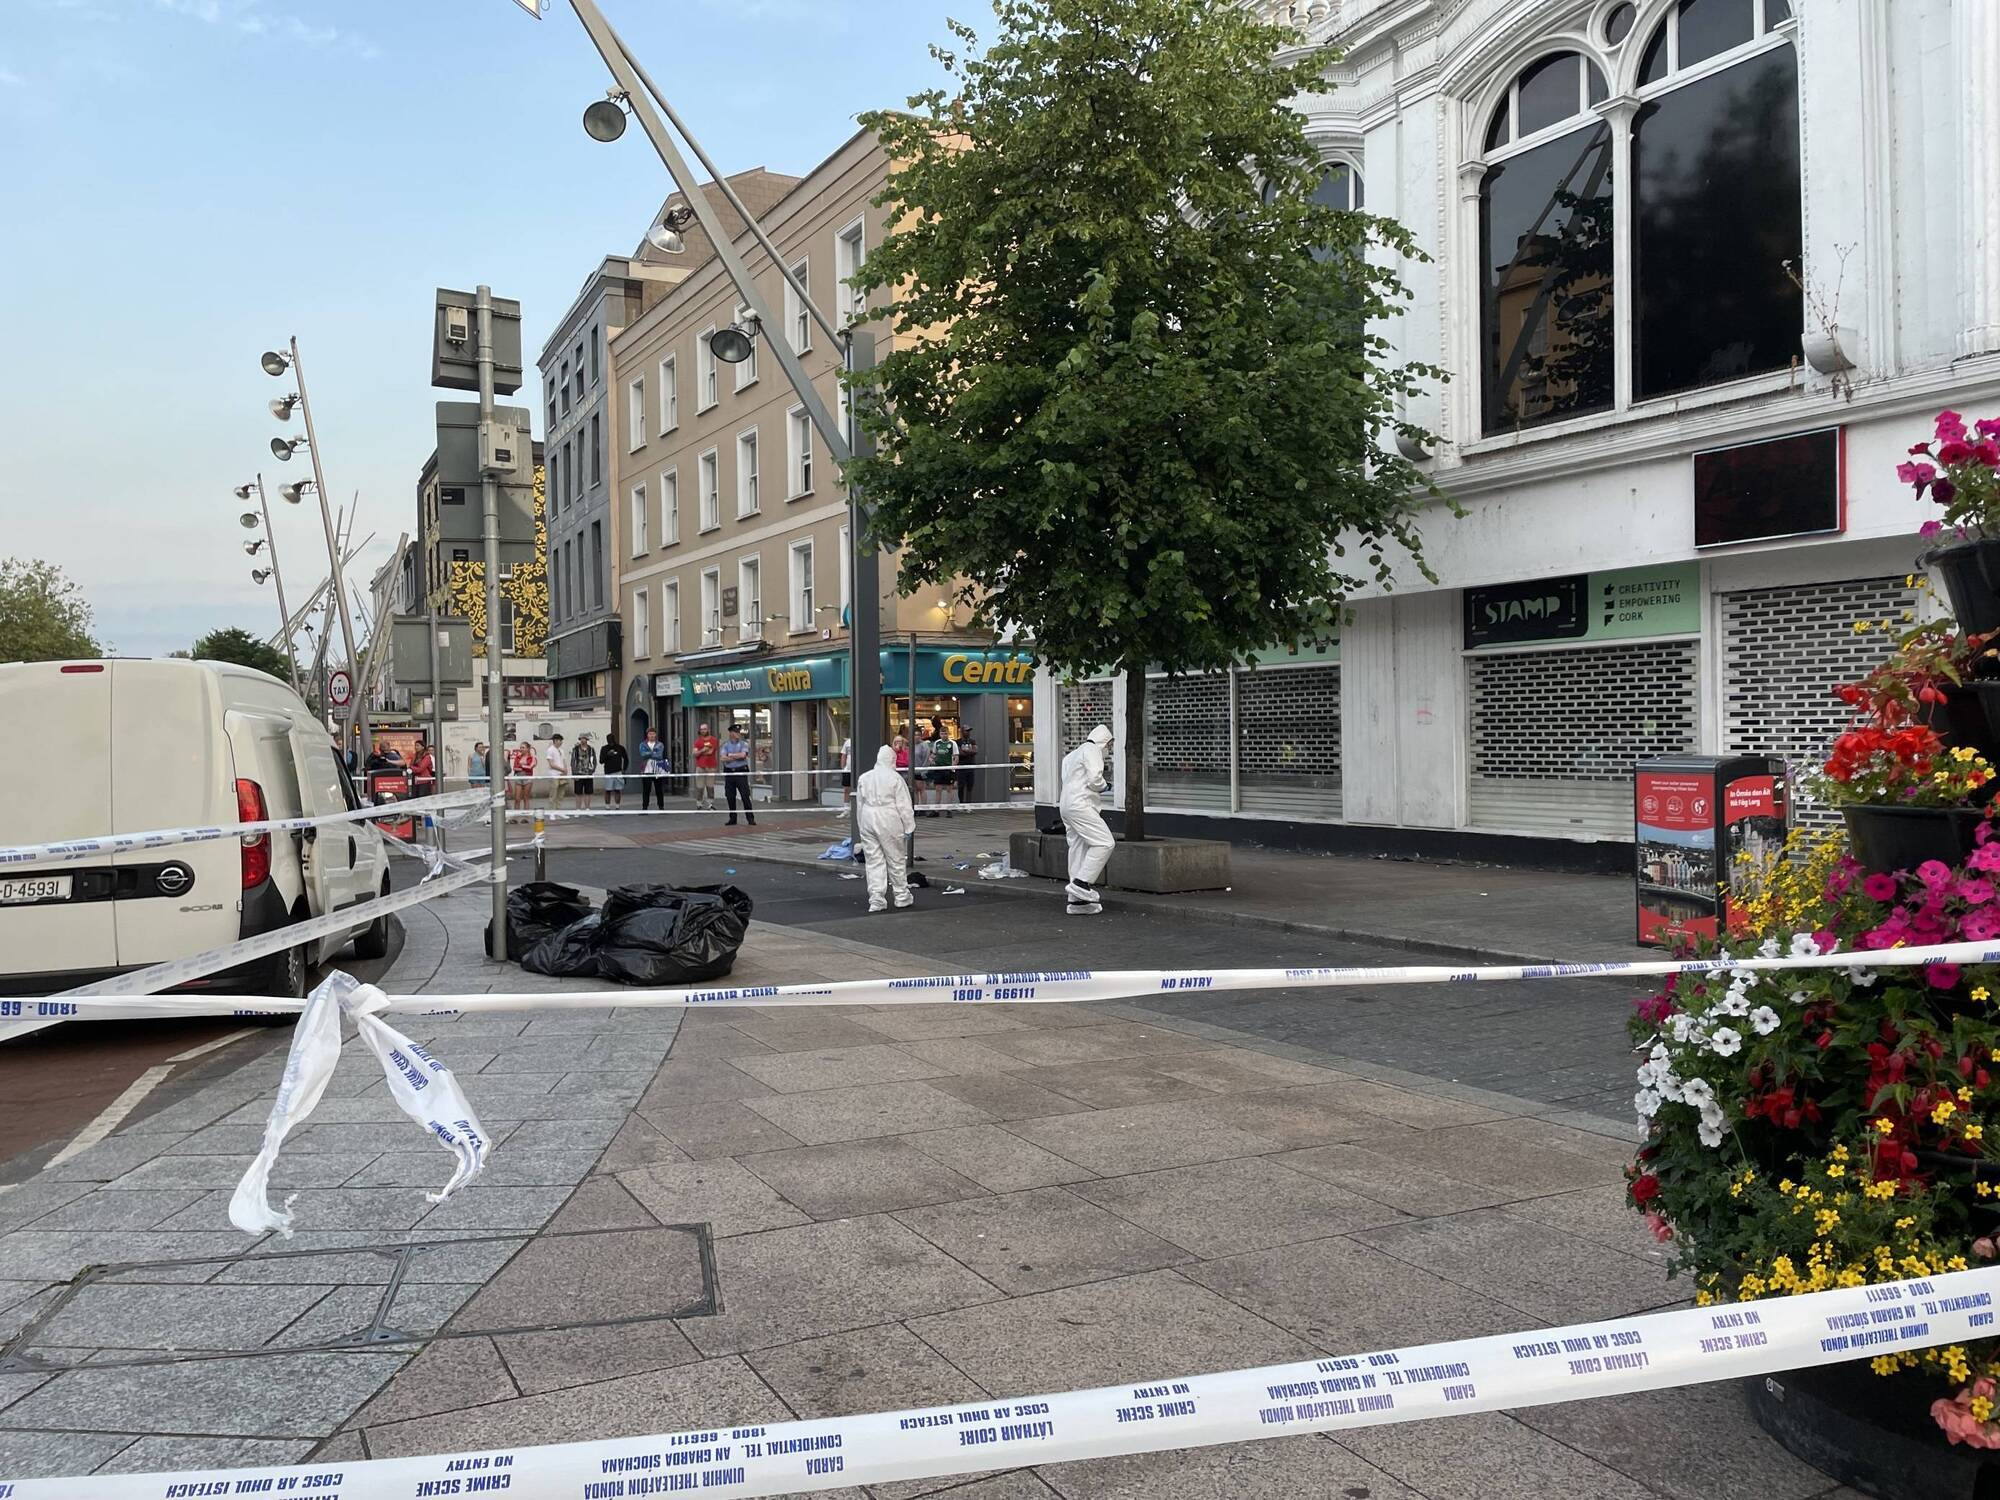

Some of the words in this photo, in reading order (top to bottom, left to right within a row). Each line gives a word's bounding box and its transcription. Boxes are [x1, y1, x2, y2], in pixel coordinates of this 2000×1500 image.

[1618, 579, 1681, 595] CREATIVITY
[1619, 594, 1681, 609] EMPOWERING
[1485, 596, 1561, 625] STAMP
[1619, 613, 1644, 622] CORK
[942, 654, 1033, 684] Centr
[767, 667, 812, 693] Centra
[1161, 978, 1177, 989] NO
[1179, 976, 1213, 988] ENTRY
[953, 989, 983, 1001] 1800
[994, 987, 1036, 1000] 666111
[1865, 1285, 1900, 1303] 666111
[1908, 1280, 1935, 1296] 1800
[1921, 1301, 1939, 1316] TEL.
[1939, 1292, 1992, 1314] CONFIDENTIAL
[1711, 1313, 1743, 1329] ENTRY
[1745, 1310, 1760, 1325] NO
[1869, 1306, 1904, 1323] GHARDA
[1904, 1305, 1916, 1320] AN
[1968, 1311, 1994, 1327] GARDA
[1826, 1312, 1868, 1331] SÍOCHÁNA
[1610, 1330, 1642, 1344] COSC
[1734, 1331, 1768, 1348] CRIME
[1850, 1327, 1898, 1348] THEILEAFÓIN
[1899, 1322, 1929, 1340] UIMHIR
[1560, 1337, 1591, 1352] DHUL
[1592, 1334, 1608, 1348] AR
[1699, 1335, 1734, 1353] SCENE
[1820, 1335, 1849, 1353] RÚNDA
[1512, 1341, 1561, 1359] ISTEACH
[1316, 1358, 1359, 1373] 666111
[1368, 1352, 1399, 1367] 1800
[1567, 1357, 1601, 1375] COIRE
[1603, 1351, 1650, 1370] LÁTHAIR
[1361, 1374, 1376, 1389] AN
[1382, 1370, 1403, 1386] TEL.
[1403, 1362, 1470, 1384] CONFIDENTIAL
[1133, 1385, 1169, 1399] ENTRY
[1172, 1383, 1189, 1394] NO
[1266, 1381, 1318, 1402] SÍOCHÁNA
[1319, 1375, 1360, 1394] GHARDA
[1442, 1383, 1476, 1401] GARDA
[1014, 1402, 1049, 1416] COSC
[1157, 1400, 1196, 1418] CRIME
[1296, 1398, 1357, 1421] THEILEAFÓIN
[1357, 1393, 1394, 1412] UIMHIR
[899, 1413, 953, 1430] ISTEACH
[956, 1409, 989, 1423] DHUL
[993, 1407, 1010, 1419] AR
[1116, 1404, 1154, 1423] SCENE
[1259, 1406, 1294, 1425] RÚNDA
[670, 1432, 718, 1446] 666111
[732, 1427, 766, 1439] 1800
[959, 1427, 997, 1446] COIRE
[1001, 1421, 1054, 1441] LÁTHAIR
[715, 1446, 731, 1461] AN
[740, 1443, 762, 1458] TEL.
[766, 1434, 842, 1456] CONFIDENTIAL
[445, 1457, 490, 1472] ENTRY
[494, 1455, 513, 1467] NO
[601, 1453, 661, 1475] SÍOCHÁNA
[665, 1448, 712, 1467] GHARDA
[806, 1455, 844, 1475] GARDA
[277, 1476, 299, 1490] AR
[302, 1473, 344, 1489] COSC
[465, 1474, 512, 1492] CRIME
[628, 1472, 699, 1498] THEILEAFÓIN
[702, 1467, 745, 1487] UIMHIR
[165, 1481, 230, 1498] ISTEACH
[235, 1478, 274, 1494] DHUL
[415, 1479, 461, 1498] SCENE
[584, 1480, 624, 1500] RÚNDA
